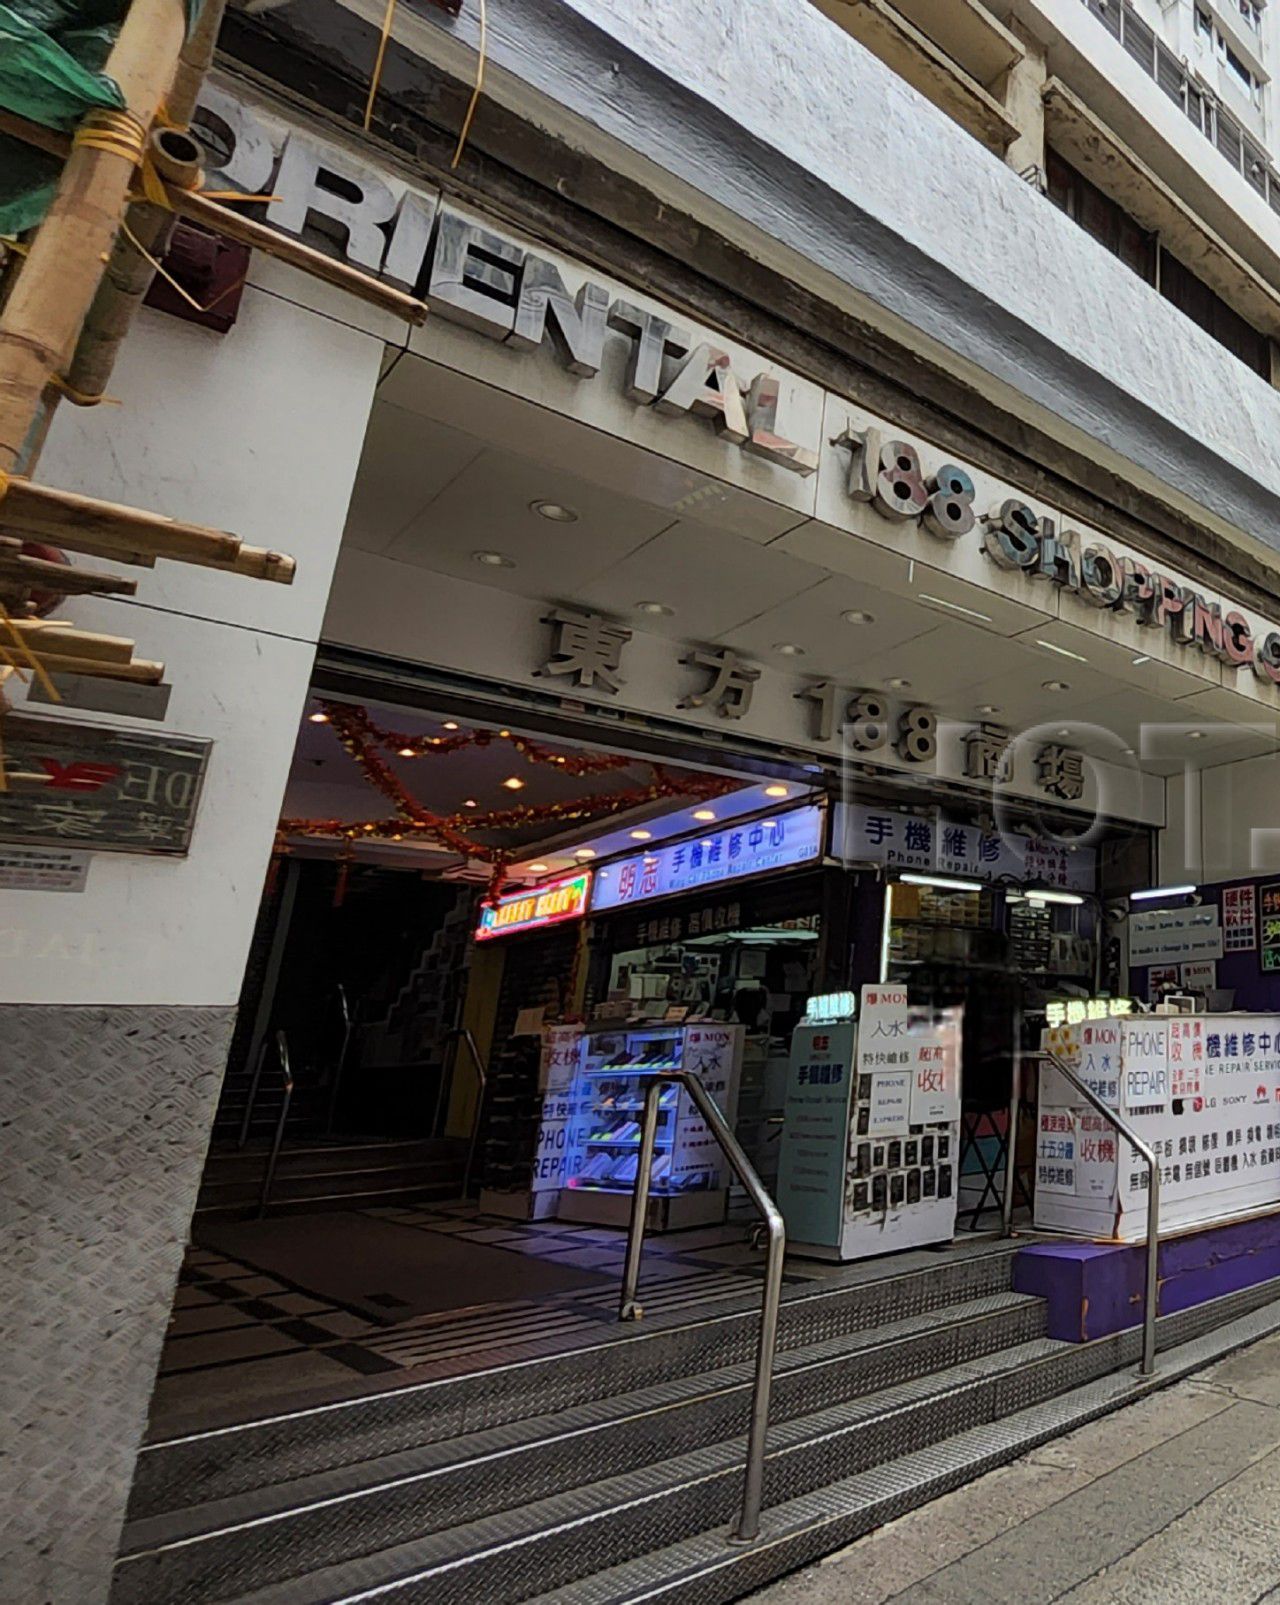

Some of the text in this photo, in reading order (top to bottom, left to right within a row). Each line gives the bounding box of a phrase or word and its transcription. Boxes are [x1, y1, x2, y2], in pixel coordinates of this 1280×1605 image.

[829, 424, 976, 541] 188
[978, 498, 1253, 666] SHOPPING
[864, 815, 1000, 863] 手機維修
[887, 849, 931, 867] Phone
[1095, 1029, 1117, 1044] MON
[1129, 1031, 1165, 1057] PHONE
[1218, 1061, 1250, 1075] REPAIR
[1128, 1071, 1167, 1096] REPAIR
[537, 1127, 585, 1149] PHONE
[1080, 1138, 1116, 1163] 收機
[532, 1154, 583, 1179] REPAIR
